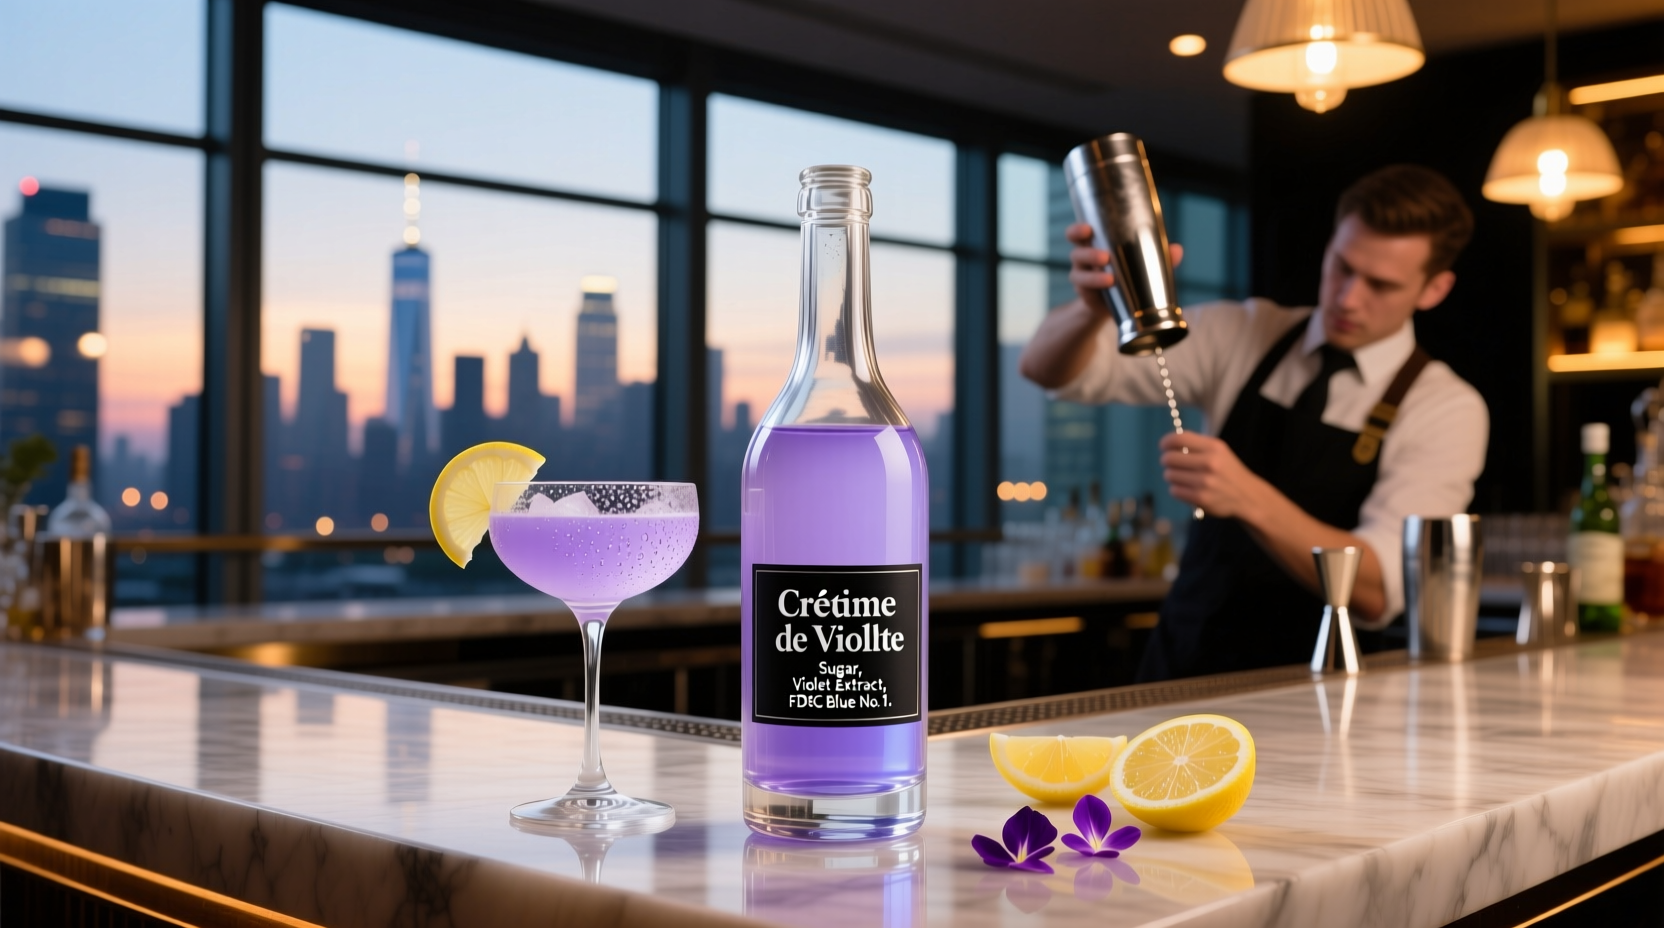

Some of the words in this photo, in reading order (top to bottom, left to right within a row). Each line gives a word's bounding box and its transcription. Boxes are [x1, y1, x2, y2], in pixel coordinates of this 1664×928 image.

[778, 589, 897, 618] Crétime
[775, 624, 808, 652] de
[812, 623, 905, 652] Viollte
[819, 661, 863, 677] Sugar,
[793, 677, 831, 691] Violet
[835, 678, 887, 694] Extract,
[826, 694, 857, 708] Blue
